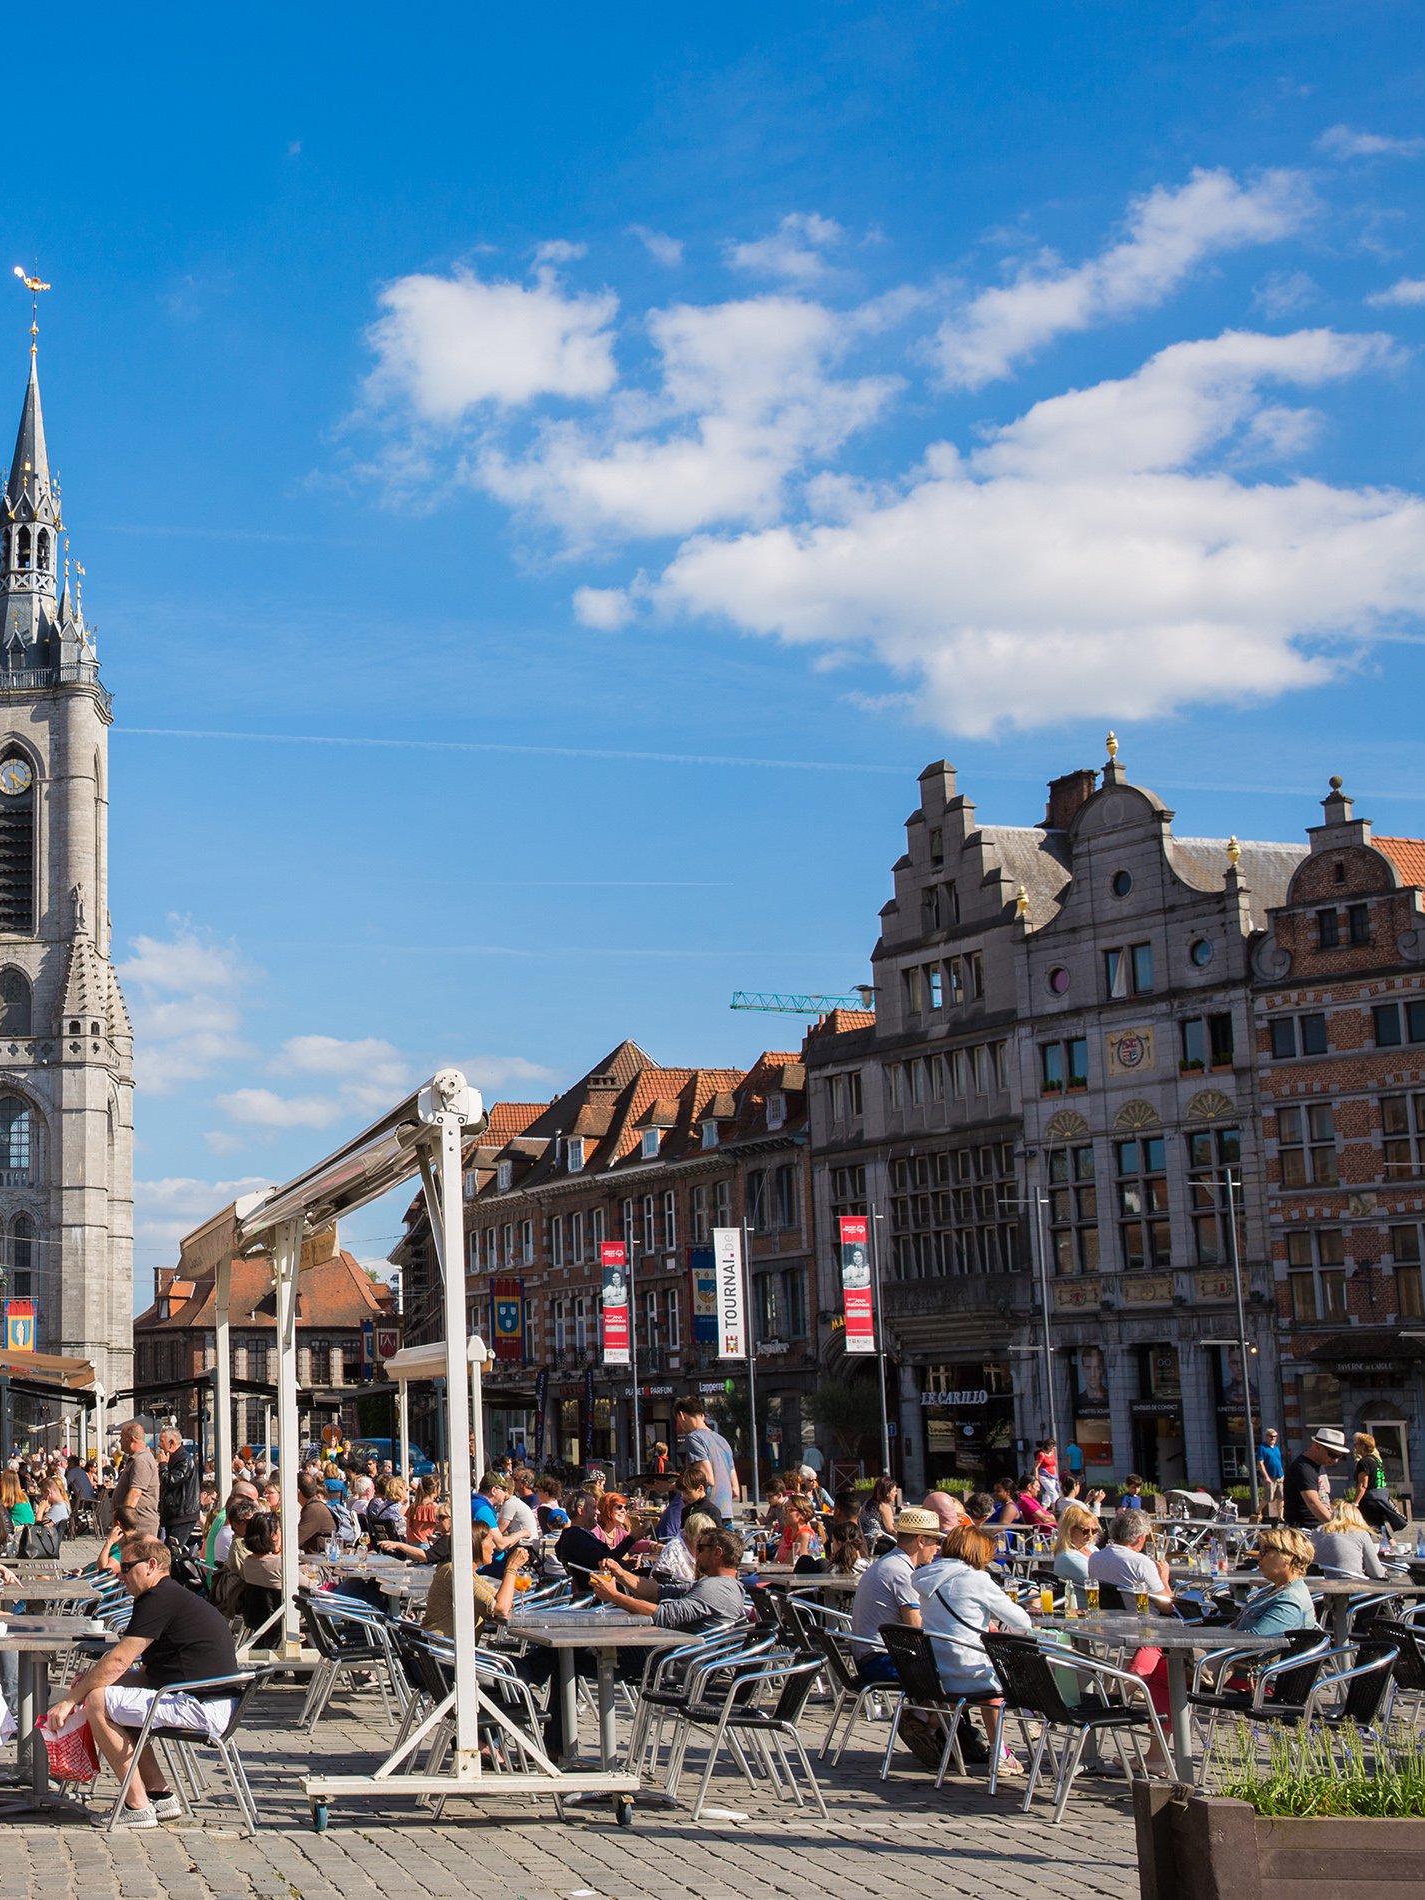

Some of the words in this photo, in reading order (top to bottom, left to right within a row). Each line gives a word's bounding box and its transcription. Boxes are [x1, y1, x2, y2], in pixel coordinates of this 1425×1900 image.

[650, 1386, 673, 1395] PARFUM
[699, 1382, 725, 1394] Lapperre
[920, 1391, 936, 1406] LE
[937, 1389, 989, 1405] CARILLO
